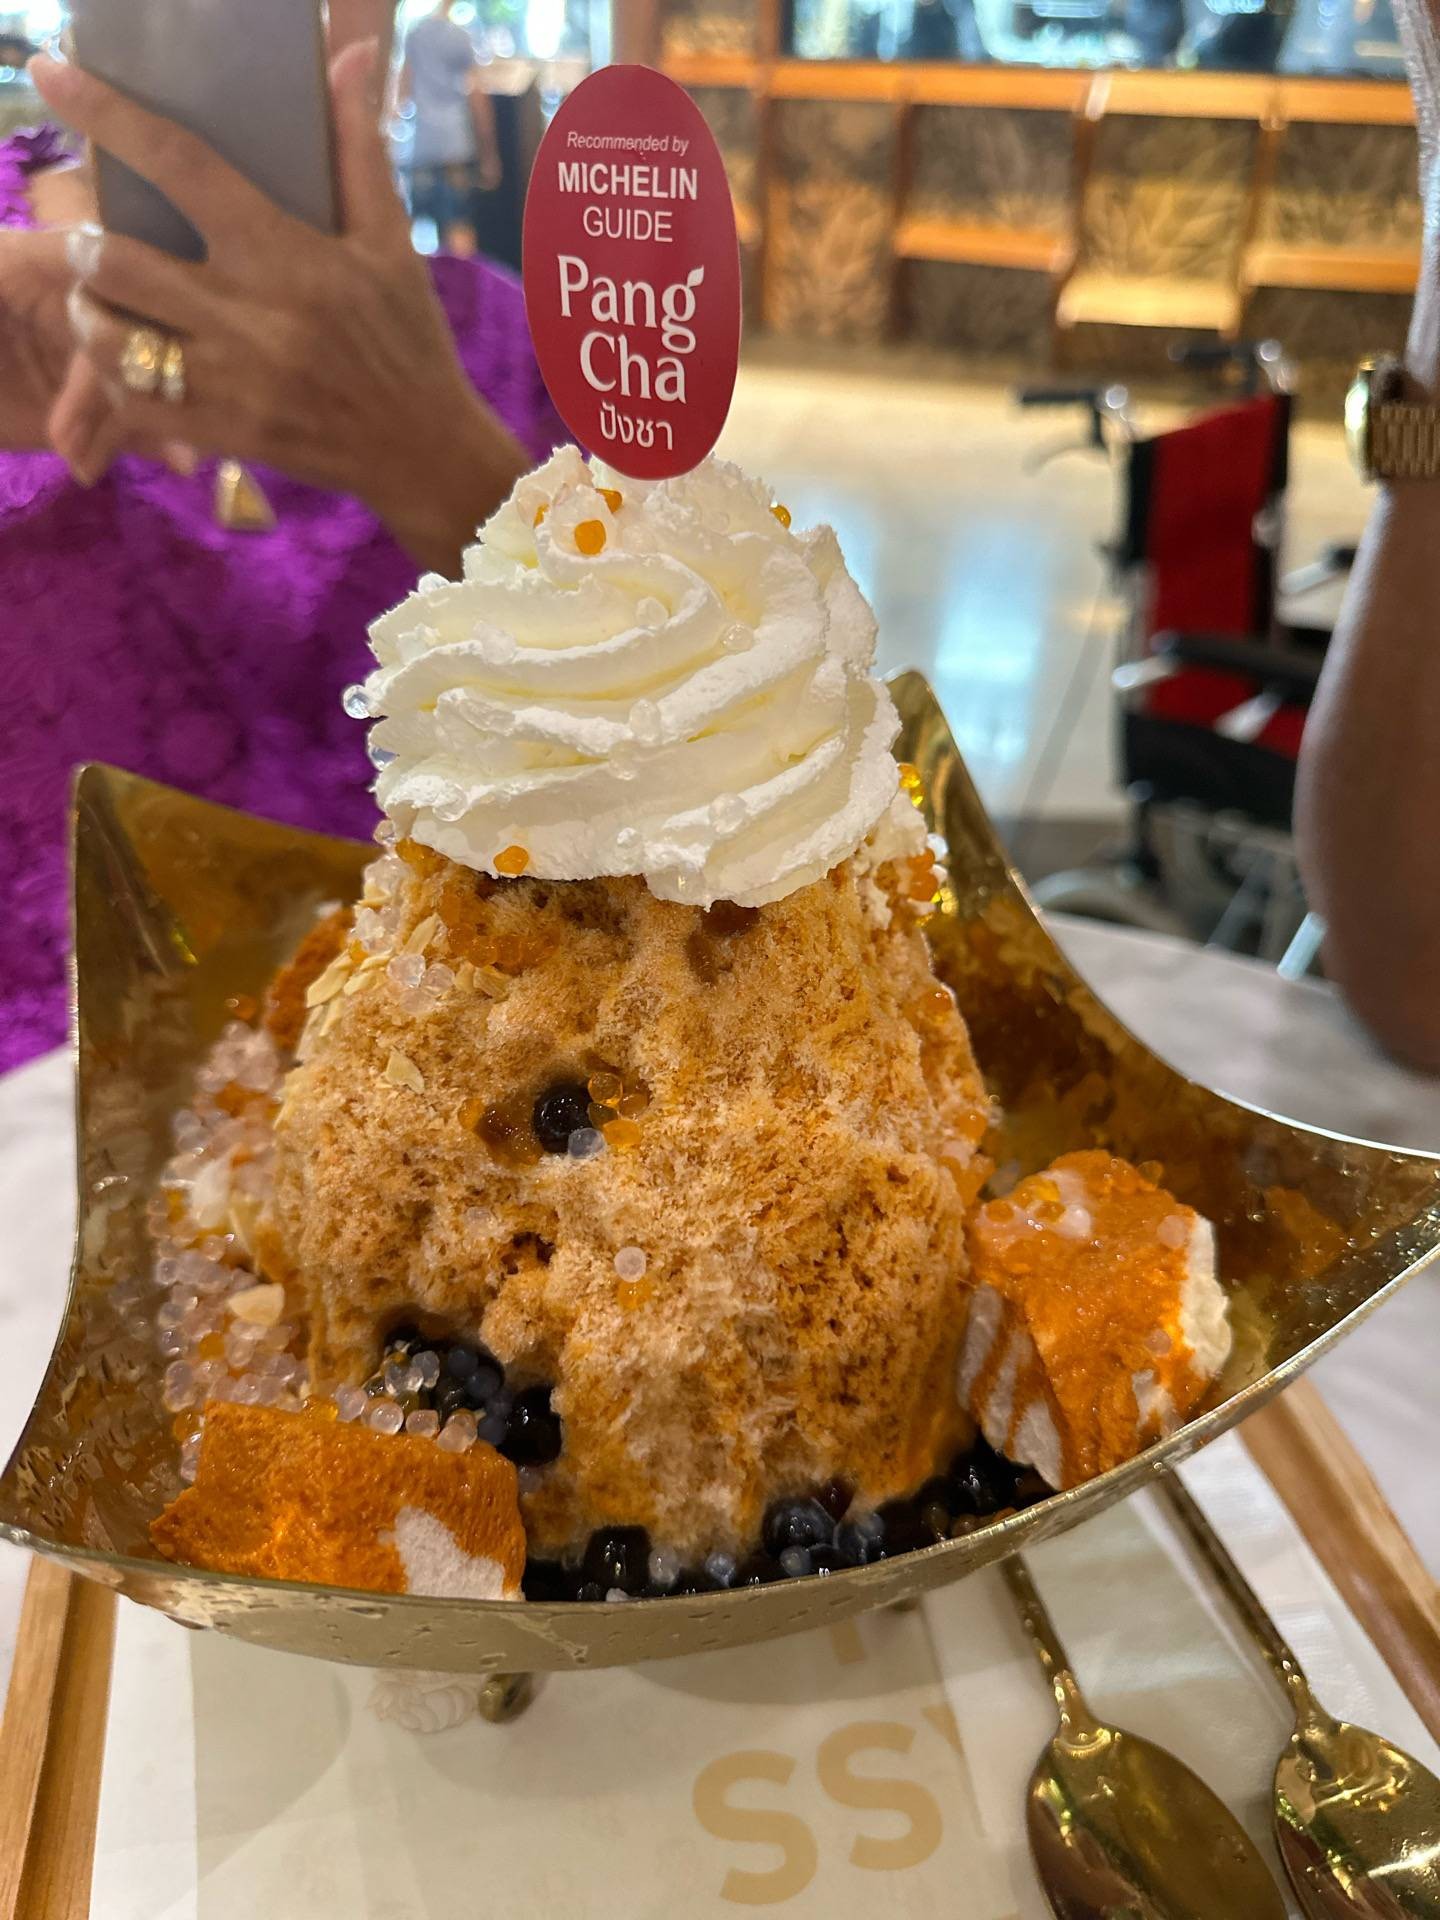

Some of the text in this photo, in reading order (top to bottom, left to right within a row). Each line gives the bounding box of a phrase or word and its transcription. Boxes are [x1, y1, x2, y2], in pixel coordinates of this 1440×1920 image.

[567, 131, 690, 157] Recommended by
[558, 161, 697, 200] MICHELIN
[583, 206, 673, 242] GUIDE
[557, 254, 704, 354] Pang
[579, 331, 687, 404] Cha
[600, 400, 673, 451] ปังชา
